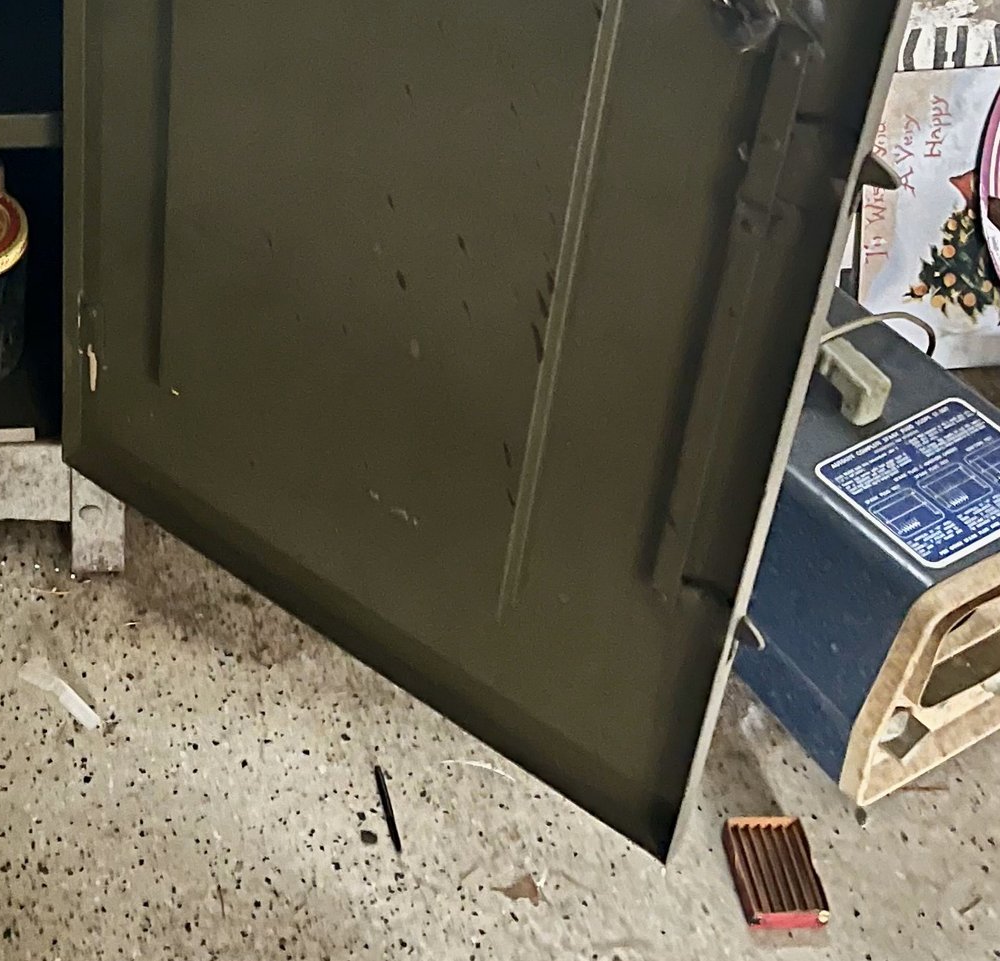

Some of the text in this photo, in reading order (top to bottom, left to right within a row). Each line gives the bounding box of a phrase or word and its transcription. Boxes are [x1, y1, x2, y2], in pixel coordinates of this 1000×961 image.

[894, 113, 921, 198] A Very
[924, 95, 951, 158] Happy
